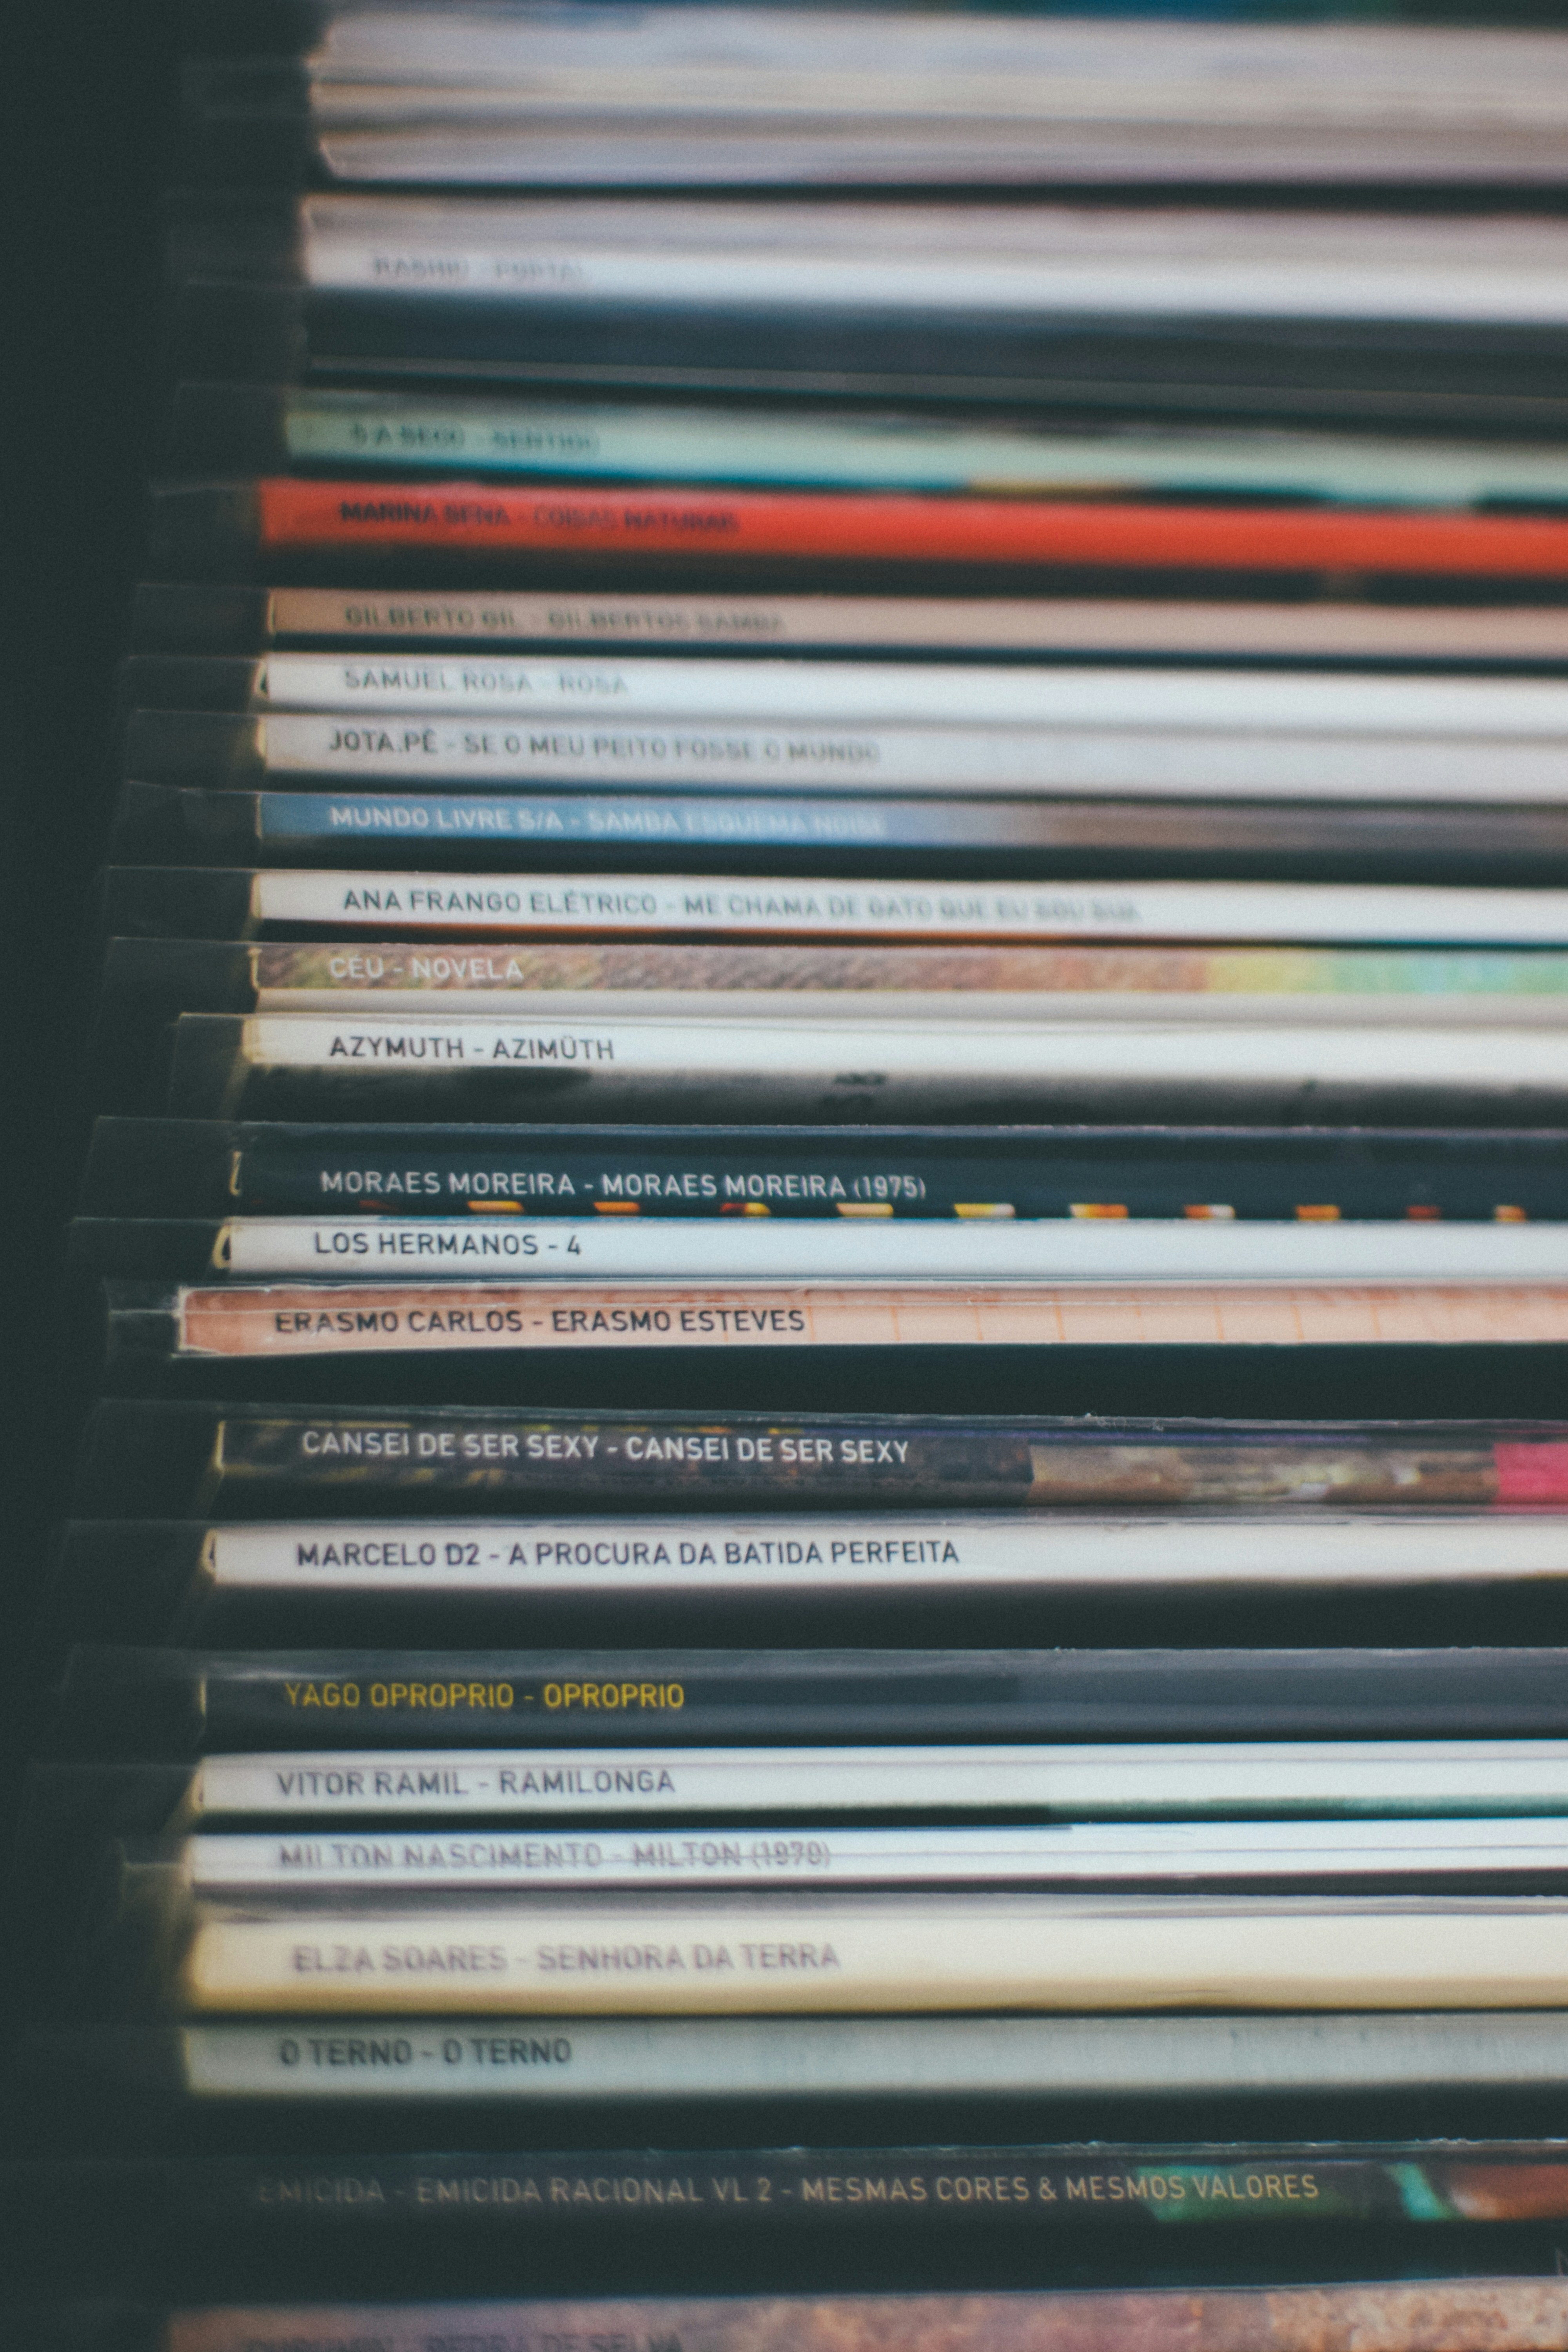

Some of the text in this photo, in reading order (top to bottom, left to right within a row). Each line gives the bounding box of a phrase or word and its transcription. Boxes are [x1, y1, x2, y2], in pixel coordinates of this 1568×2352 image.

[339, 501, 434, 524] MARINA
[447, 504, 510, 526] SENA
[624, 510, 741, 534] NATURAIS
[345, 606, 473, 629] GILBERTO
[481, 608, 517, 630] GIL
[548, 609, 689, 632] GILBERTOS
[695, 612, 784, 633] SAMBA
[345, 669, 452, 691] SAMUEL
[463, 671, 532, 692] ROSA
[559, 672, 629, 693] ROSA
[464, 732, 496, 754] SE
[504, 733, 521, 755] O
[529, 734, 585, 757] MEU
[592, 735, 666, 758] PEITO
[674, 737, 756, 760] FOSSE
[764, 739, 782, 761] O
[788, 739, 880, 763] MUNDO
[330, 806, 430, 829] MUNDO
[437, 808, 512, 830] LIVRE
[517, 809, 564, 832] S/A
[587, 810, 681, 833] SAMBA
[685, 813, 808, 837] ESQUEMA
[814, 815, 887, 839] NOISE
[344, 890, 401, 911] ANA
[410, 891, 521, 912] FRANGO
[530, 888, 657, 914] ELÉTRICO
[685, 894, 720, 916] ME
[728, 895, 820, 917] CHAMA
[828, 897, 856, 918] DE
[868, 897, 934, 919] GATO
[941, 898, 985, 920] QUE
[996, 899, 1029, 920] EU
[1035, 899, 1087, 921] SOU
[412, 957, 524, 980] NOVELA
[328, 1036, 464, 1058] AZYMUTH
[321, 1171, 441, 1194] MORAES
[448, 1172, 576, 1195] MOREIRA
[601, 1173, 718, 1197] MORAES
[724, 1174, 846, 1197] MOREIRA
[851, 1175, 927, 1200] (1975)
[314, 1232, 370, 1254] LOS
[379, 1233, 539, 1255] HERMANOS
[566, 1235, 582, 1255] 4
[275, 1311, 399, 1333] ERASMO
[407, 1310, 524, 1332] CARLOS
[552, 1310, 671, 1332] ERASMO
[680, 1309, 805, 1332] ESTEVES
[302, 1431, 410, 1455] CANSEI
[418, 1433, 456, 1456] DE
[463, 1434, 519, 1457] SER
[526, 1434, 599, 1459] SEXY
[625, 1436, 728, 1461] CANSEI
[736, 1437, 771, 1462] DE
[779, 1438, 834, 1463] SER
[840, 1439, 911, 1465] SEXY
[298, 1543, 436, 1566] MARCELO
[445, 1543, 480, 1566] D2
[509, 1543, 527, 1565] A
[535, 1542, 671, 1566] PROCURA
[679, 1542, 717, 1565] DA
[724, 1541, 824, 1564] BATIDA
[831, 1540, 960, 1564] PERFEITA
[283, 1683, 360, 1707] YAGO
[370, 1682, 514, 1708] OPROPRIO
[543, 1682, 685, 1709] OPROPRIO
[277, 1772, 364, 1796] VITOR
[375, 1771, 468, 1795] RAMIL
[499, 1769, 675, 1794] RAMILONGA
[280, 1843, 392, 1867] MILTON
[404, 1842, 602, 1867] NASCIMENTO
[632, 1842, 741, 1867] MILTON
[292, 1946, 376, 1975] ELZA
[382, 1945, 508, 1972] SOARES
[537, 1944, 687, 1971] SENHORA
[693, 1944, 735, 1970] DA
[740, 1942, 839, 1970] TERRA
[280, 2039, 299, 2066] O
[308, 2038, 412, 2067] TERNO
[443, 2038, 462, 2065] O
[470, 2037, 572, 2065] TERNO
[258, 2177, 386, 2203] EMICIDA
[416, 2178, 541, 2203] EMICIDA
[551, 2177, 704, 2203] RACIONAL
[712, 2178, 749, 2202] VL
[757, 2176, 772, 2202] 2
[802, 2176, 928, 2202] MESMAS
[935, 2176, 1030, 2202] CORES
[1038, 2176, 1058, 2201] &
[1065, 2174, 1186, 2201] MESMOS
[1192, 2173, 1319, 2200] VALORES
